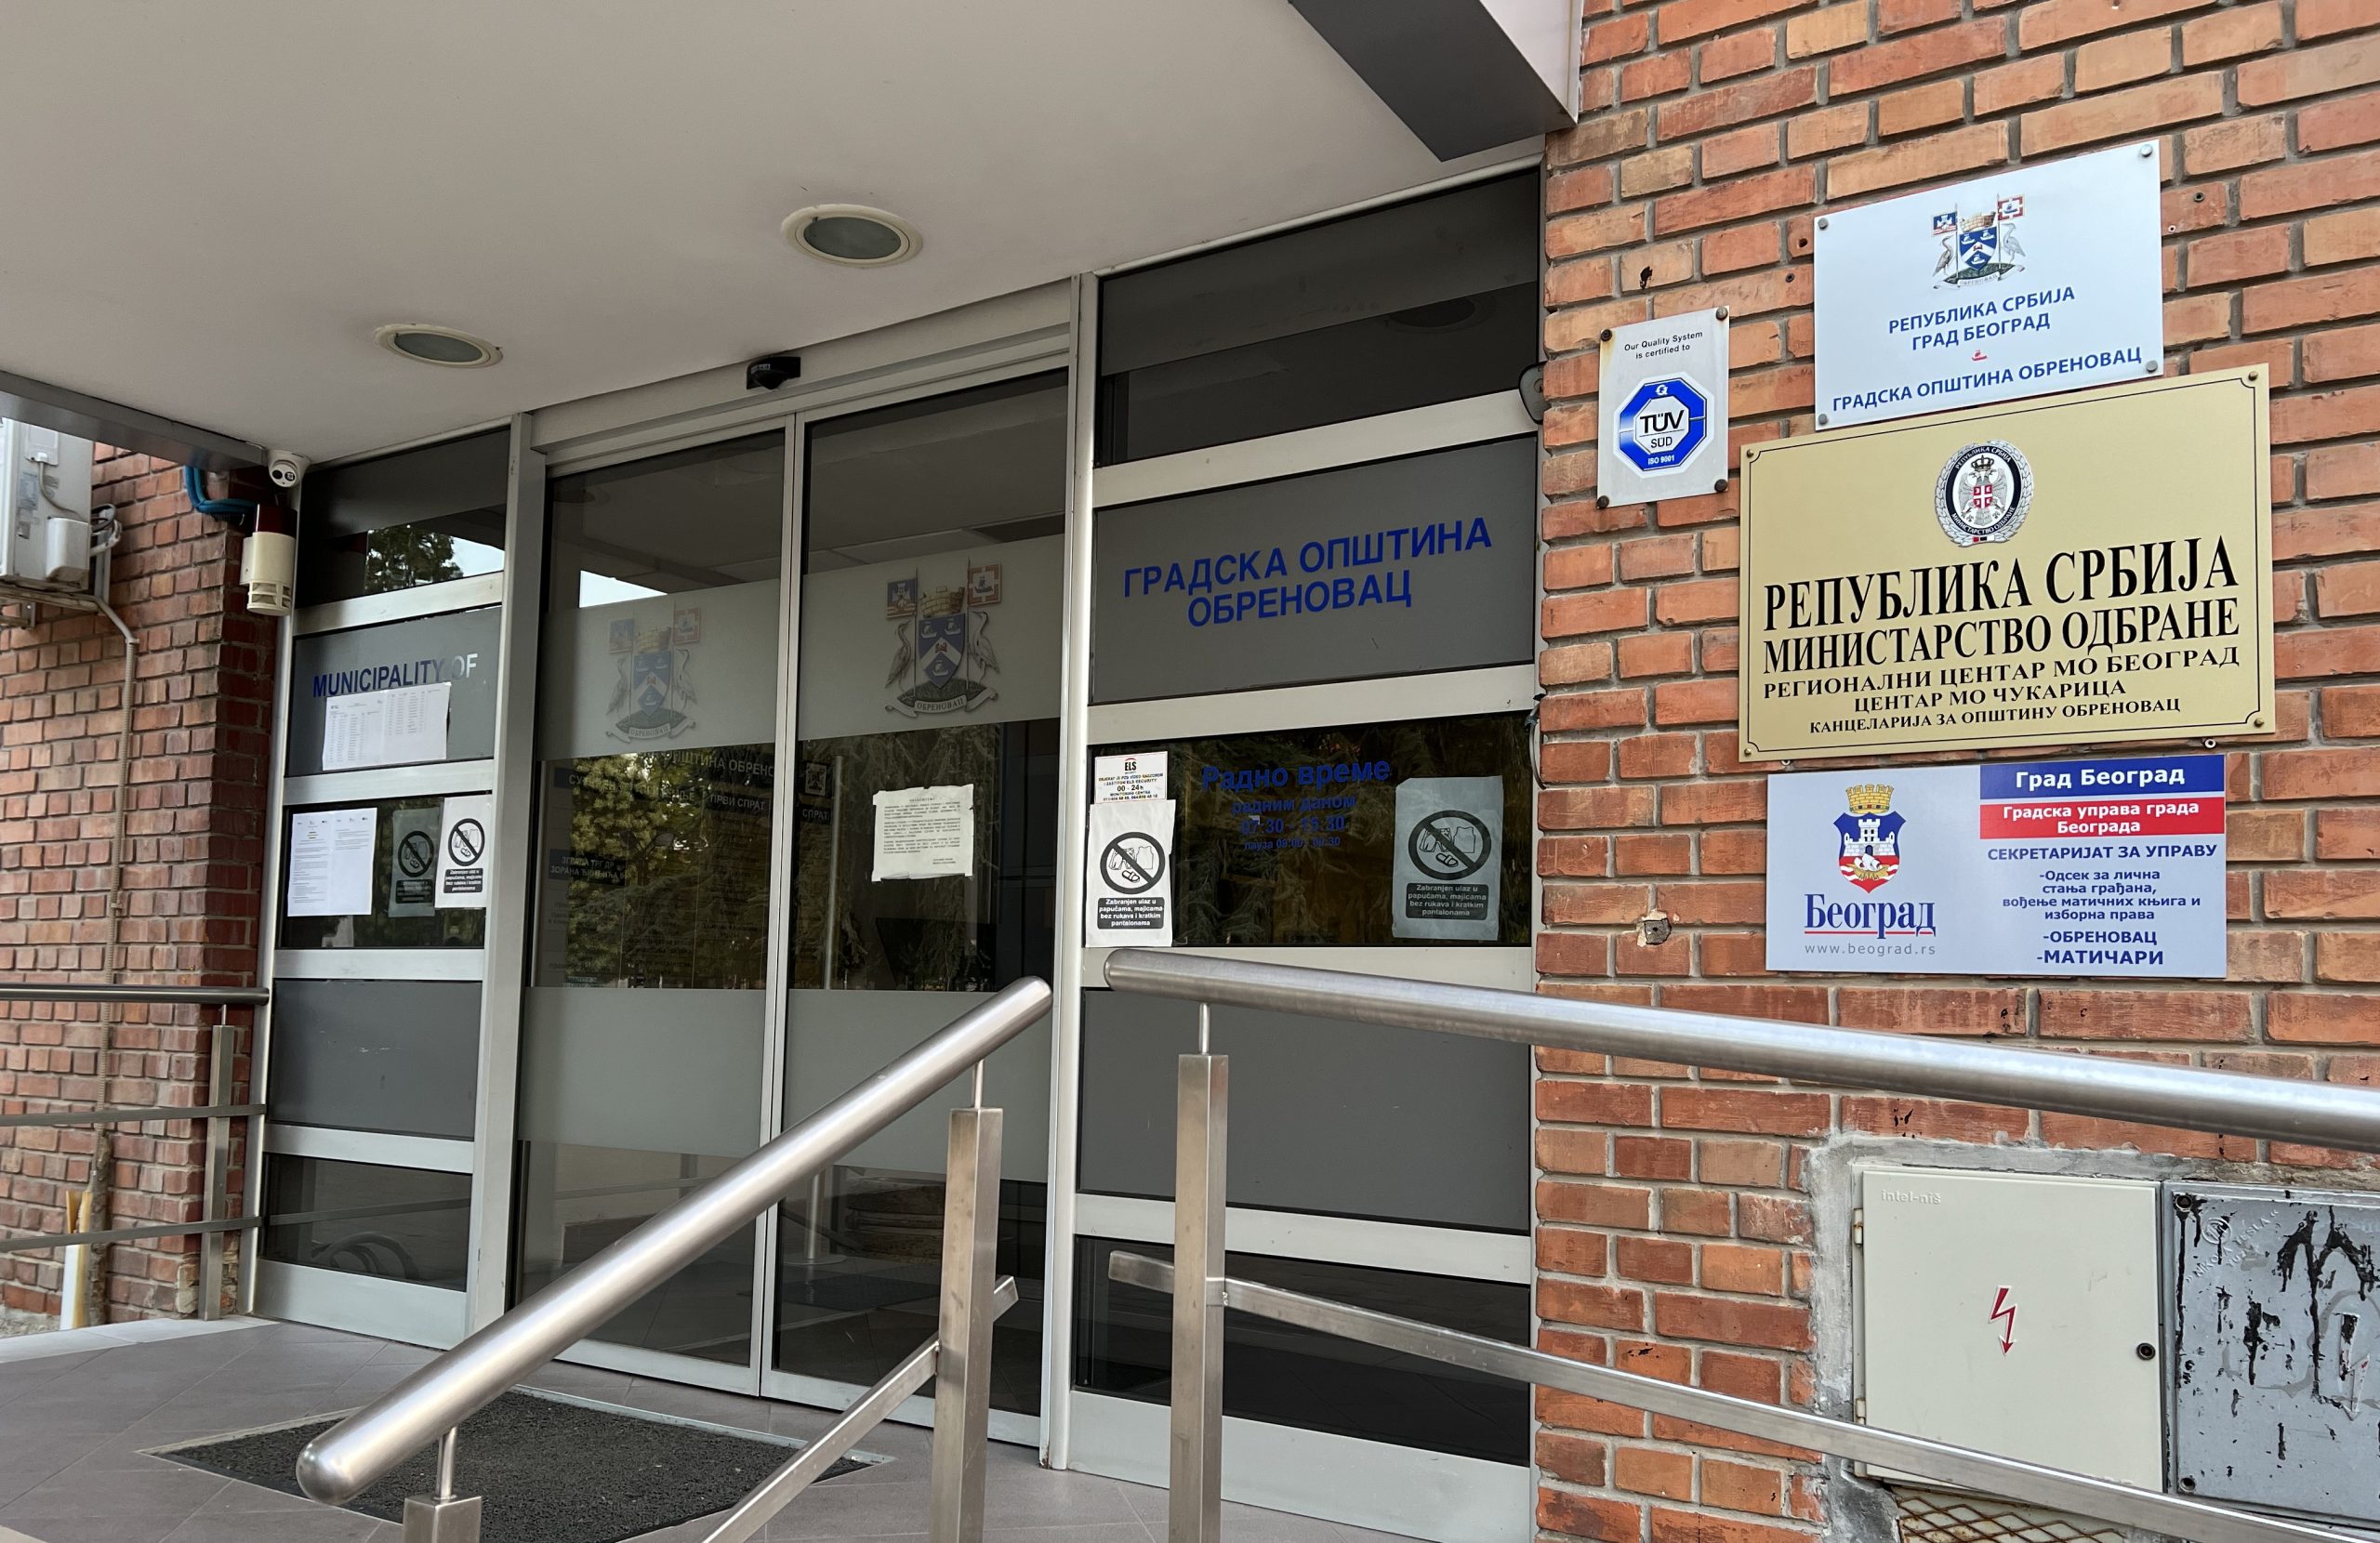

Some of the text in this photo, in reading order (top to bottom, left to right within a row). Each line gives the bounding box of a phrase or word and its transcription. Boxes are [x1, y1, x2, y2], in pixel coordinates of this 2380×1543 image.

[1889, 286, 2075, 335] РЕПУБЛИКА СРБИЈА
[1642, 336, 1670, 348] Quality
[1673, 331, 1703, 343] System
[1912, 313, 2050, 351] ГРАД БЕОГРАД
[1646, 346, 1679, 358] certified
[1832, 347, 2142, 412] ГРАДСКА ОПШТИНА ОБРЕНОВАЦ
[1640, 410, 1685, 433] TÜV
[1650, 437, 1672, 448] SÜD
[1648, 455, 1674, 465] ISO 9001
[1124, 518, 1492, 598] ГРАДСКА ОПШТИНА
[1765, 535, 2239, 631] РЕПУБЛИКА СРБИЈА
[1188, 570, 1412, 627] ОБРЕНОВАЦ
[1764, 598, 2240, 674] МИНИСТАРСТВО ОДБРАНЕ
[312, 653, 478, 697] MUNICIPALITY OF
[1764, 647, 2240, 700] РЕГИОНАЛНИ ЦЕНТАР МО БЕОГРАД
[917, 697, 964, 711] ОБРЕНОВАЦ
[1854, 680, 2126, 714] ЦЕНТАР МО ЧУКАРИЦА
[1810, 698, 2181, 734] КАНЦЕЛАРИЈА ЗА ОПШТИНУ ОБРЕНОВАЦ
[1125, 761, 1137, 771] ELS
[1202, 760, 1390, 793] Радно време
[2016, 767, 2185, 790] Град Београд
[737, 797, 765, 811] СПРАТ
[1232, 795, 1355, 816] радним даном
[2003, 801, 2199, 820] Градска управа града
[802, 809, 828, 821] СПРАТ
[2057, 818, 2141, 837] Београда
[1244, 840, 1273, 851] пауза
[1988, 844, 2217, 861] СЕКРЕТАРИЈАТ ЗА УПРАВУ
[2040, 869, 2160, 881] -Одсек за лична
[2043, 882, 2157, 897] стања грађана,
[2003, 895, 2201, 909] вођење матичних књига и
[1805, 894, 1937, 939] Београд
[2044, 909, 2155, 922] изборна права
[2043, 930, 2157, 947] -ОБРЕНОВАЦ
[1805, 943, 1936, 957] www.beograd.rs
[2037, 950, 2163, 967] -МАТИЧАРИ
[1881, 1189, 1941, 1205] intel-niš
